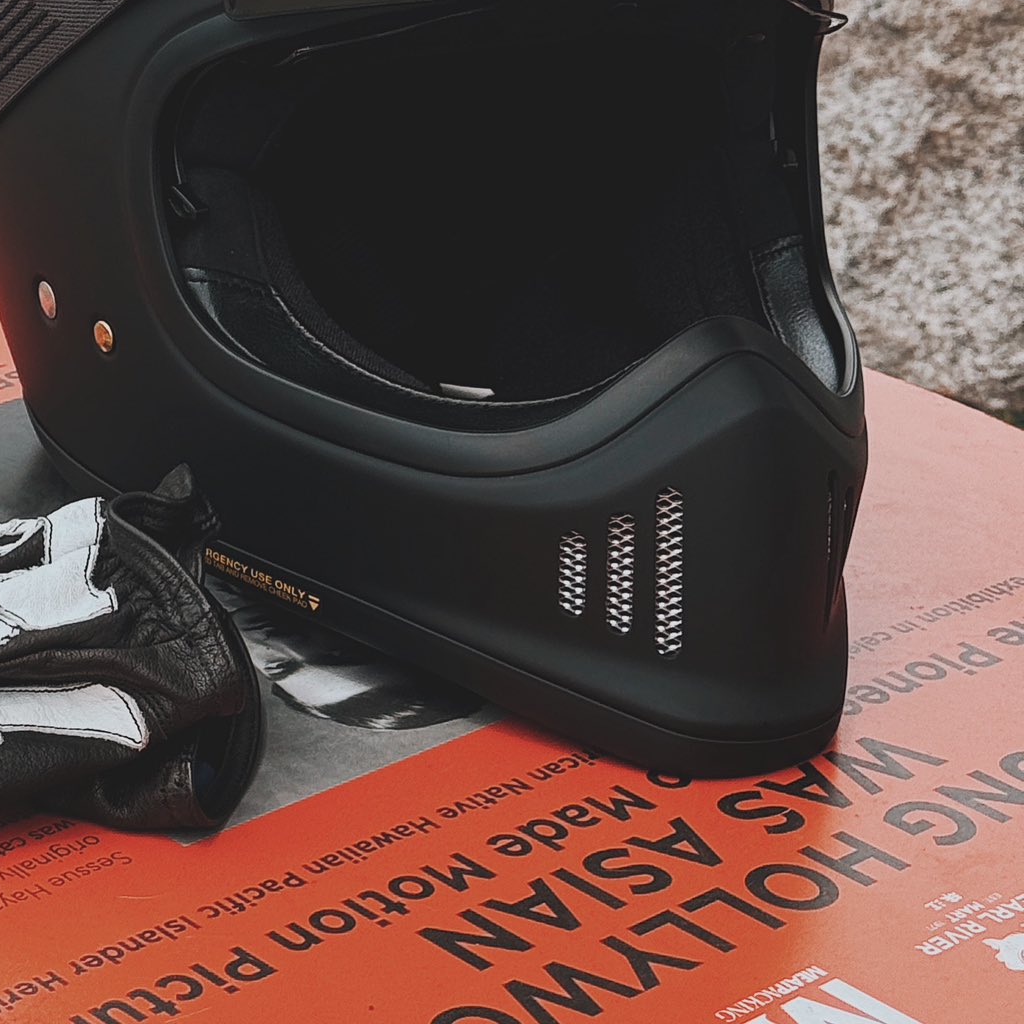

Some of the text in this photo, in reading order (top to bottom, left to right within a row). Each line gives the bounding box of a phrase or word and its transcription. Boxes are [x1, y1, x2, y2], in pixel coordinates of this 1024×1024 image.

[205, 548, 248, 573] RGENCY
[250, 568, 273, 586] USE
[275, 579, 306, 599] ONLY
[891, 620, 928, 634] in
[435, 777, 535, 819] Native
[486, 784, 658, 857] Made
[28, 818, 76, 841] was
[307, 816, 442, 874] Hawaiian
[416, 736, 949, 972] WAS ASIAN
[47, 850, 133, 888] Sessue
[205, 873, 307, 922] Pacific
[266, 852, 498, 953] Motion
[945, 900, 986, 924] MART
[67, 918, 202, 977] Islander
[914, 919, 988, 956] RIVER
[714, 965, 829, 1023] MEATPACKING
